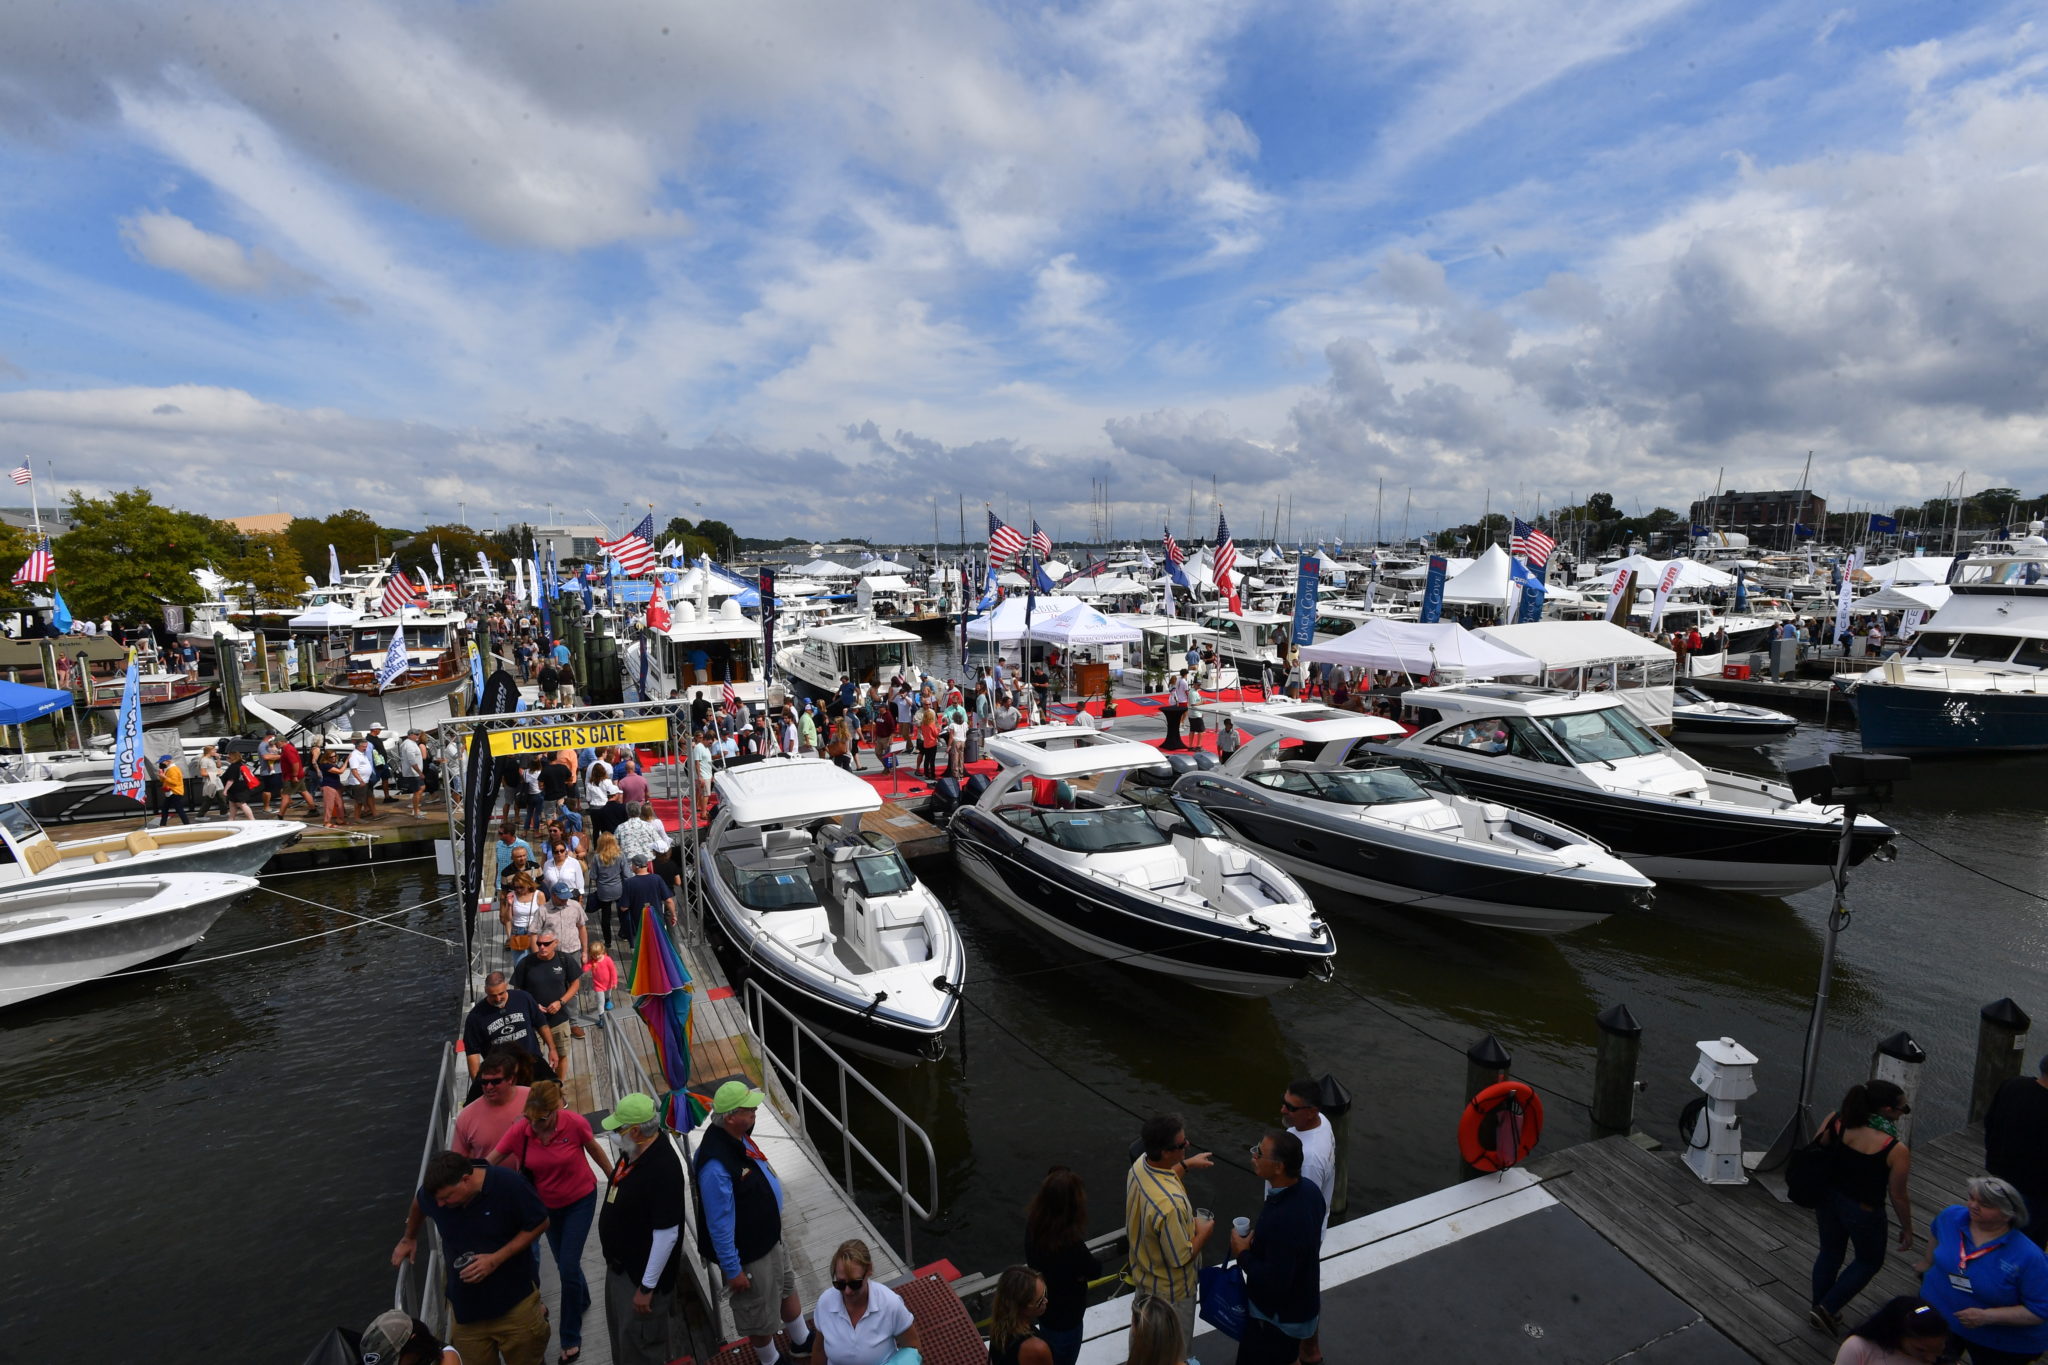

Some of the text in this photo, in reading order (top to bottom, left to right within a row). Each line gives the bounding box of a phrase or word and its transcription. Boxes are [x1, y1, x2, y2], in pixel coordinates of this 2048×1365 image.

[1303, 561, 1319, 574] 41
[1661, 566, 1678, 594] mjm
[1301, 580, 1315, 610] COVE
[1612, 569, 1628, 596] mjm
[512, 723, 626, 750] PUSSER'S GATE
[1908, 1040, 1922, 1053] 1
